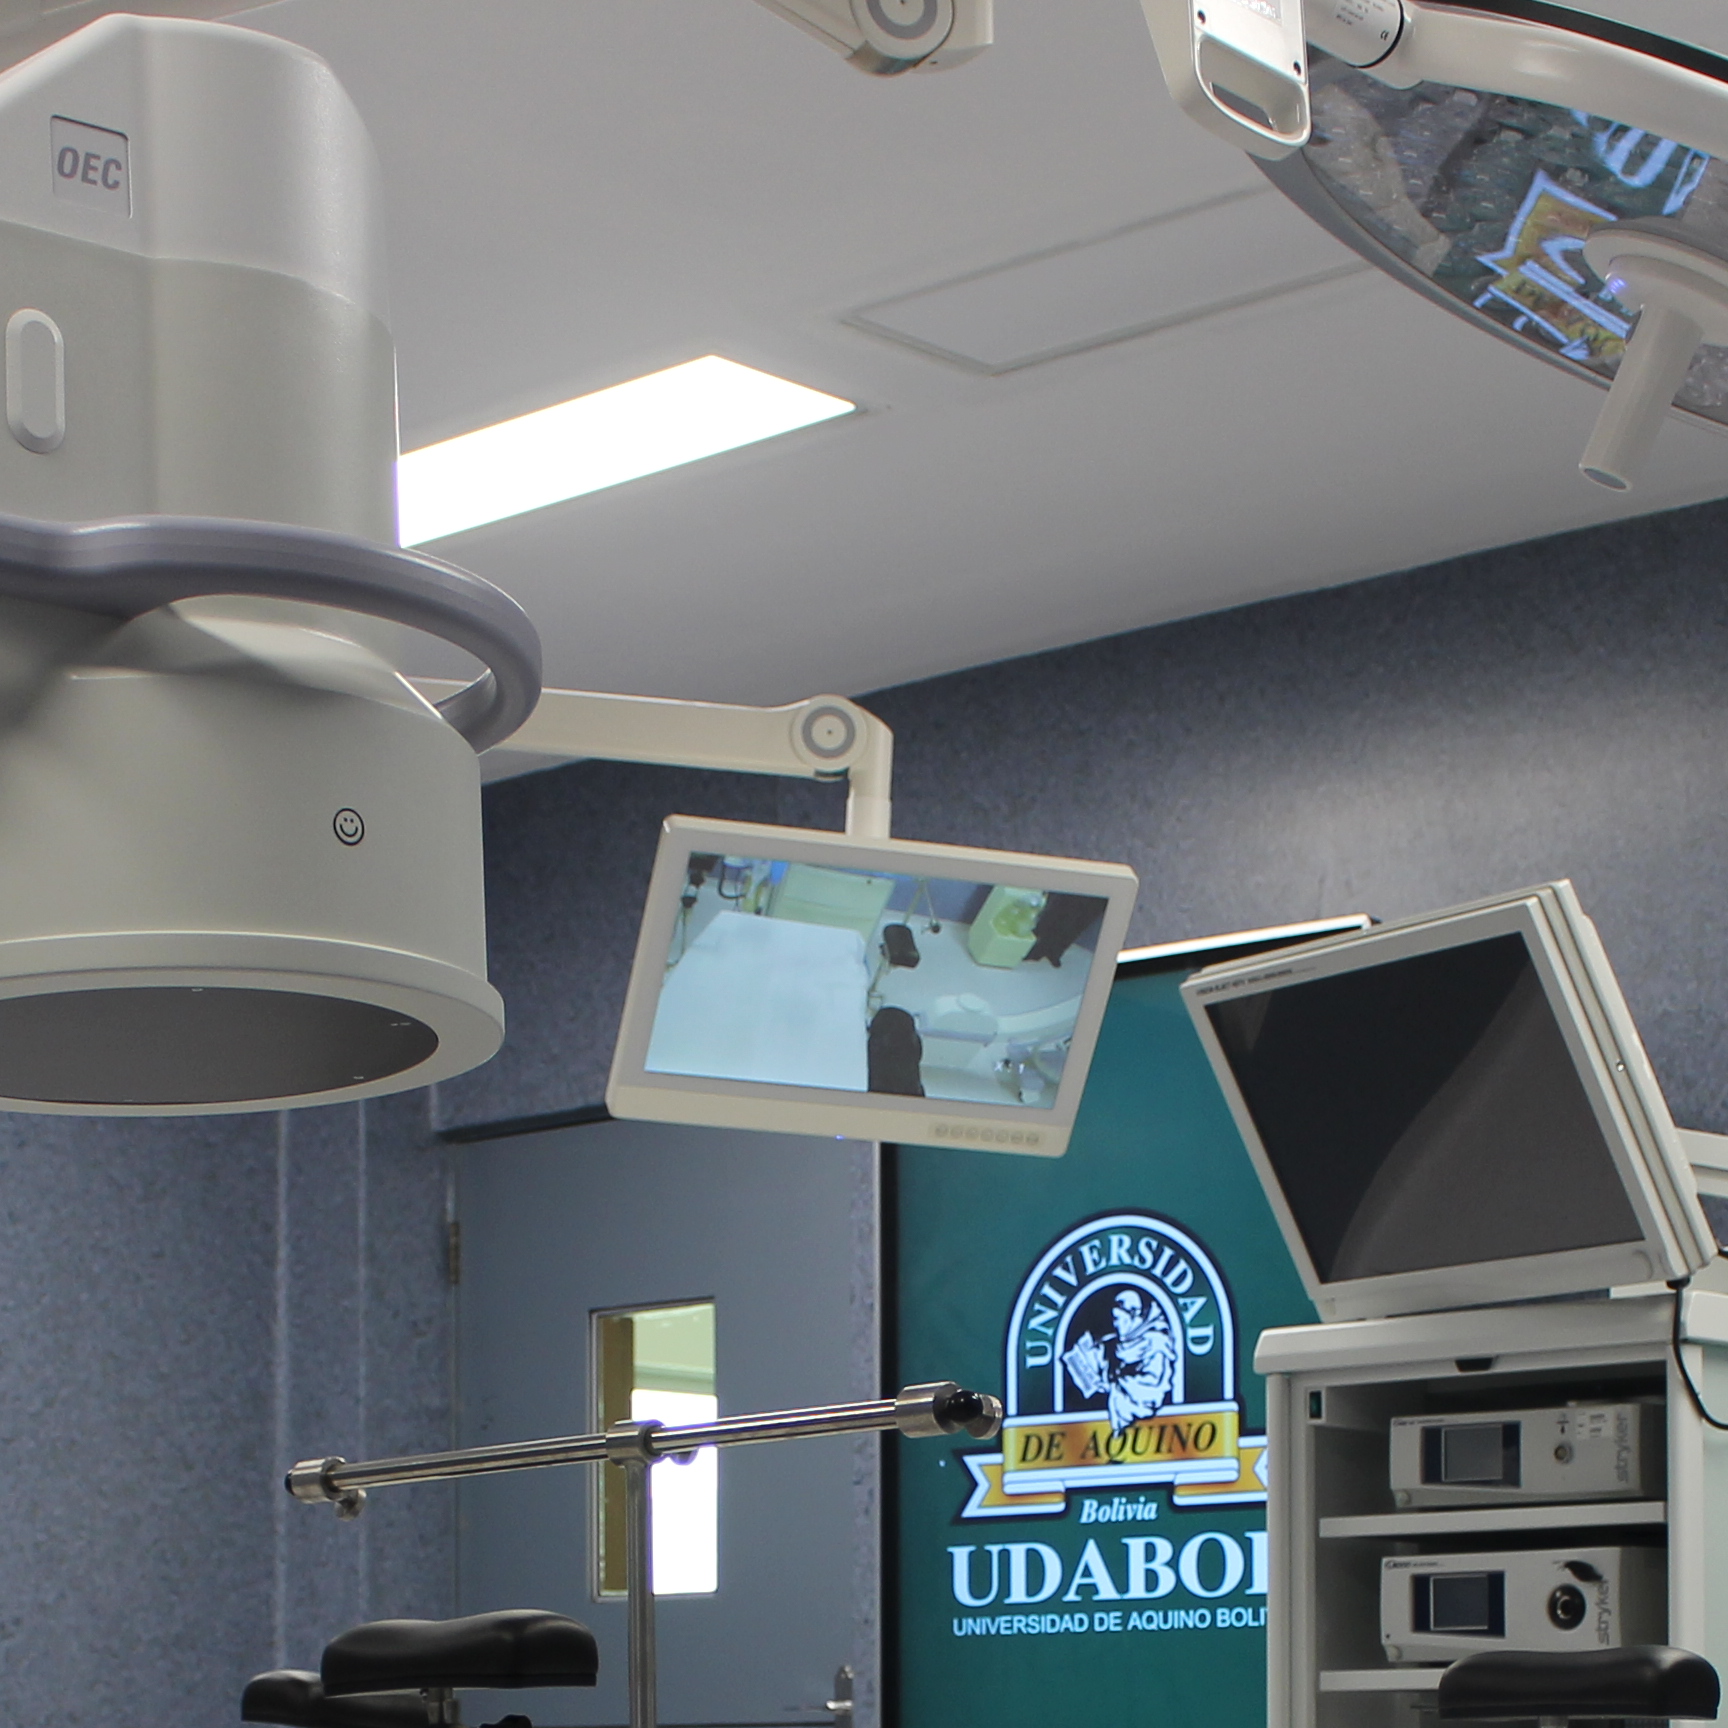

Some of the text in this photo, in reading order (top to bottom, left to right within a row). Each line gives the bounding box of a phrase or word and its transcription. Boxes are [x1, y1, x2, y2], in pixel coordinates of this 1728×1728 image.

[56, 146, 122, 191] OEC
[1025, 1233, 1216, 1369] UNIVERSIDAD
[1019, 1421, 1218, 1465] DE AQUINO
[1614, 1413, 1632, 1484] stryker
[1079, 1497, 1158, 1524] Bolivia
[952, 1605, 1268, 1637] UNIVERSIDAD DE AQUINO BOLI
[1595, 1579, 1612, 1646] stryker
